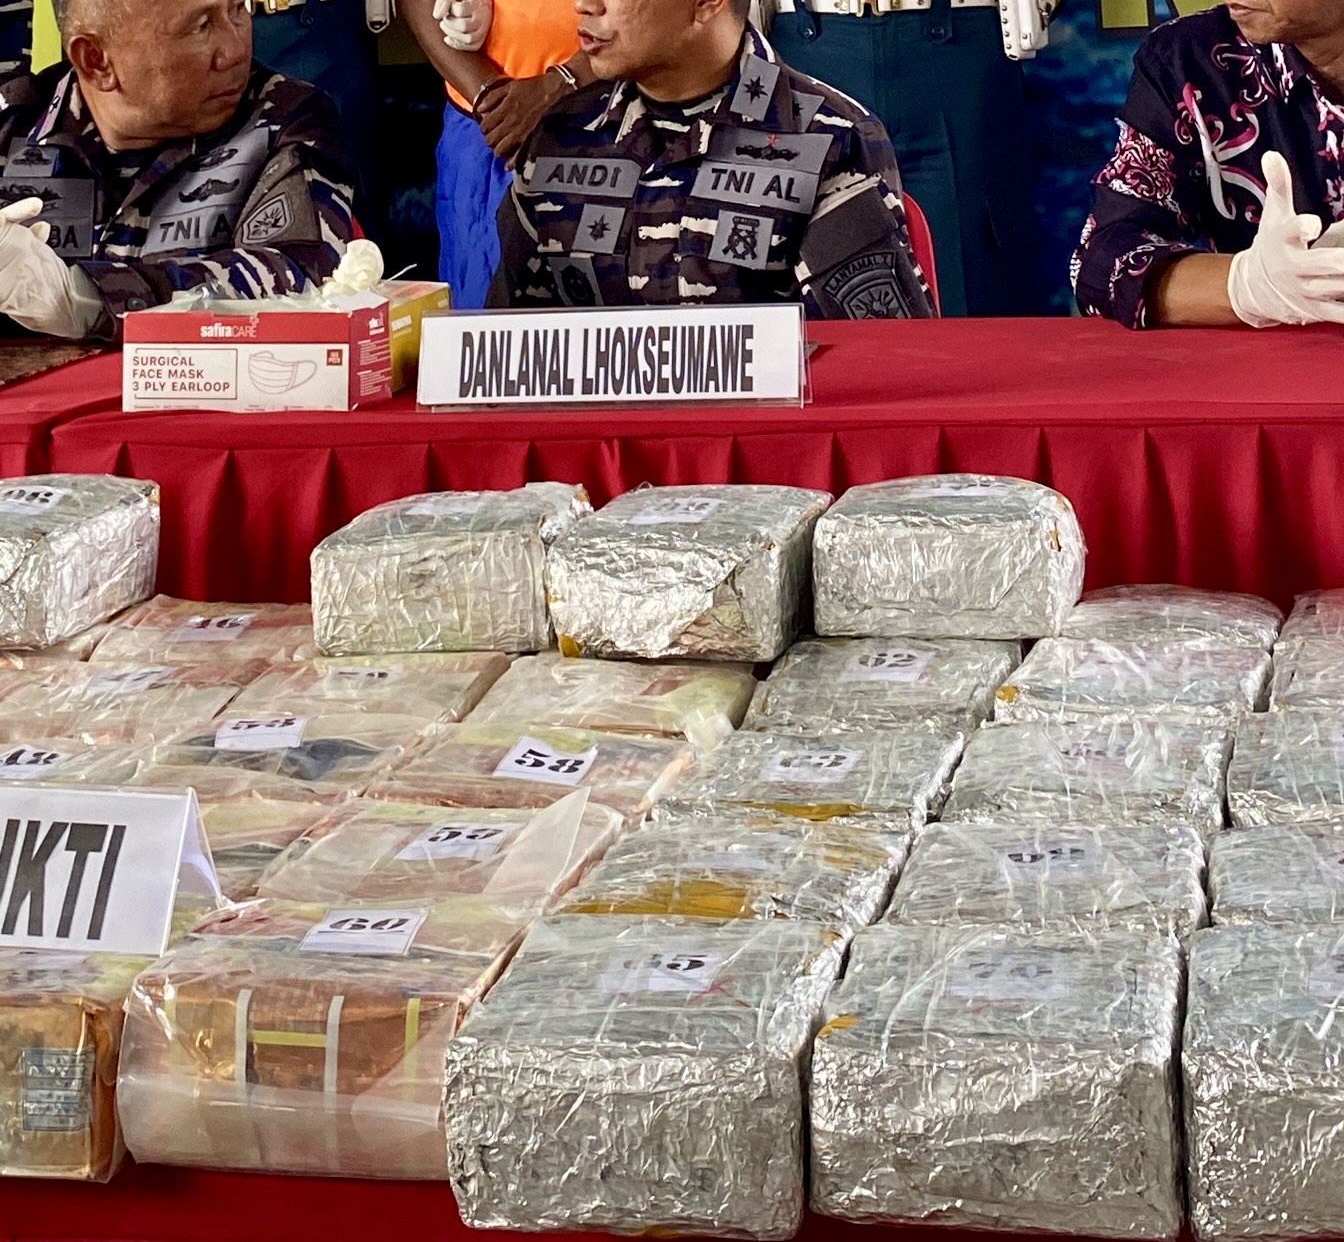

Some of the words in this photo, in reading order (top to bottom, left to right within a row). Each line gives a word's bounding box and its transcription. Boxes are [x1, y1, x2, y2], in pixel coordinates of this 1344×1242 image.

[546, 163, 622, 188] ANDI
[710, 168, 756, 195] TNI
[763, 174, 801, 203] AL
[159, 217, 200, 243] TNI
[132, 355, 195, 367] SURGICAL
[132, 368, 165, 379] FACE
[168, 368, 204, 379] MASK
[458, 328, 574, 398] DANLANAL
[581, 324, 754, 395] LHOKSEUMAWE
[132, 381, 140, 392] 3
[144, 381, 166, 392] PLY
[171, 380, 231, 392] EARLOOP
[514, 748, 586, 775] 58
